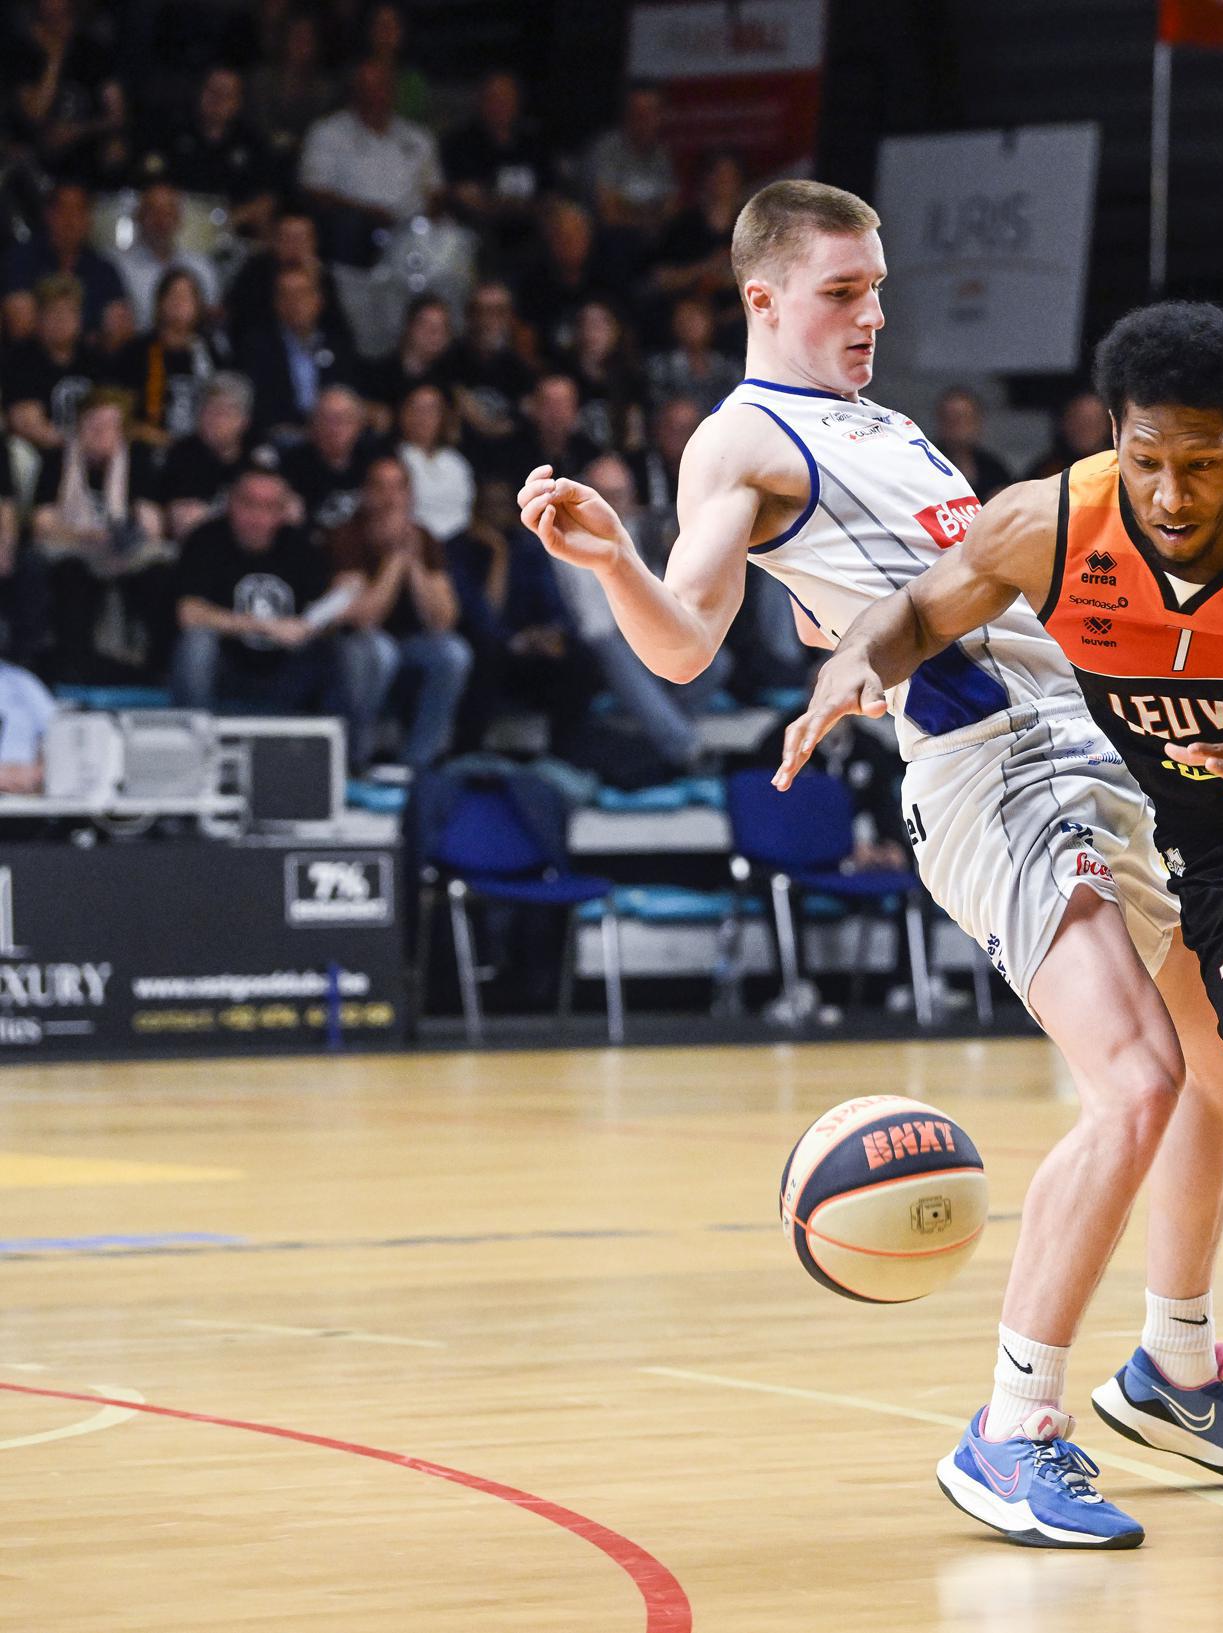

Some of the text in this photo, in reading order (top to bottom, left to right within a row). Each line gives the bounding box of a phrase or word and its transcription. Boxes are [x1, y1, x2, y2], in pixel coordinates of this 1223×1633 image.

[1081, 635, 1117, 648] leuven
[308, 861, 371, 900] 7%
[862, 1120, 956, 1171] BNXT
